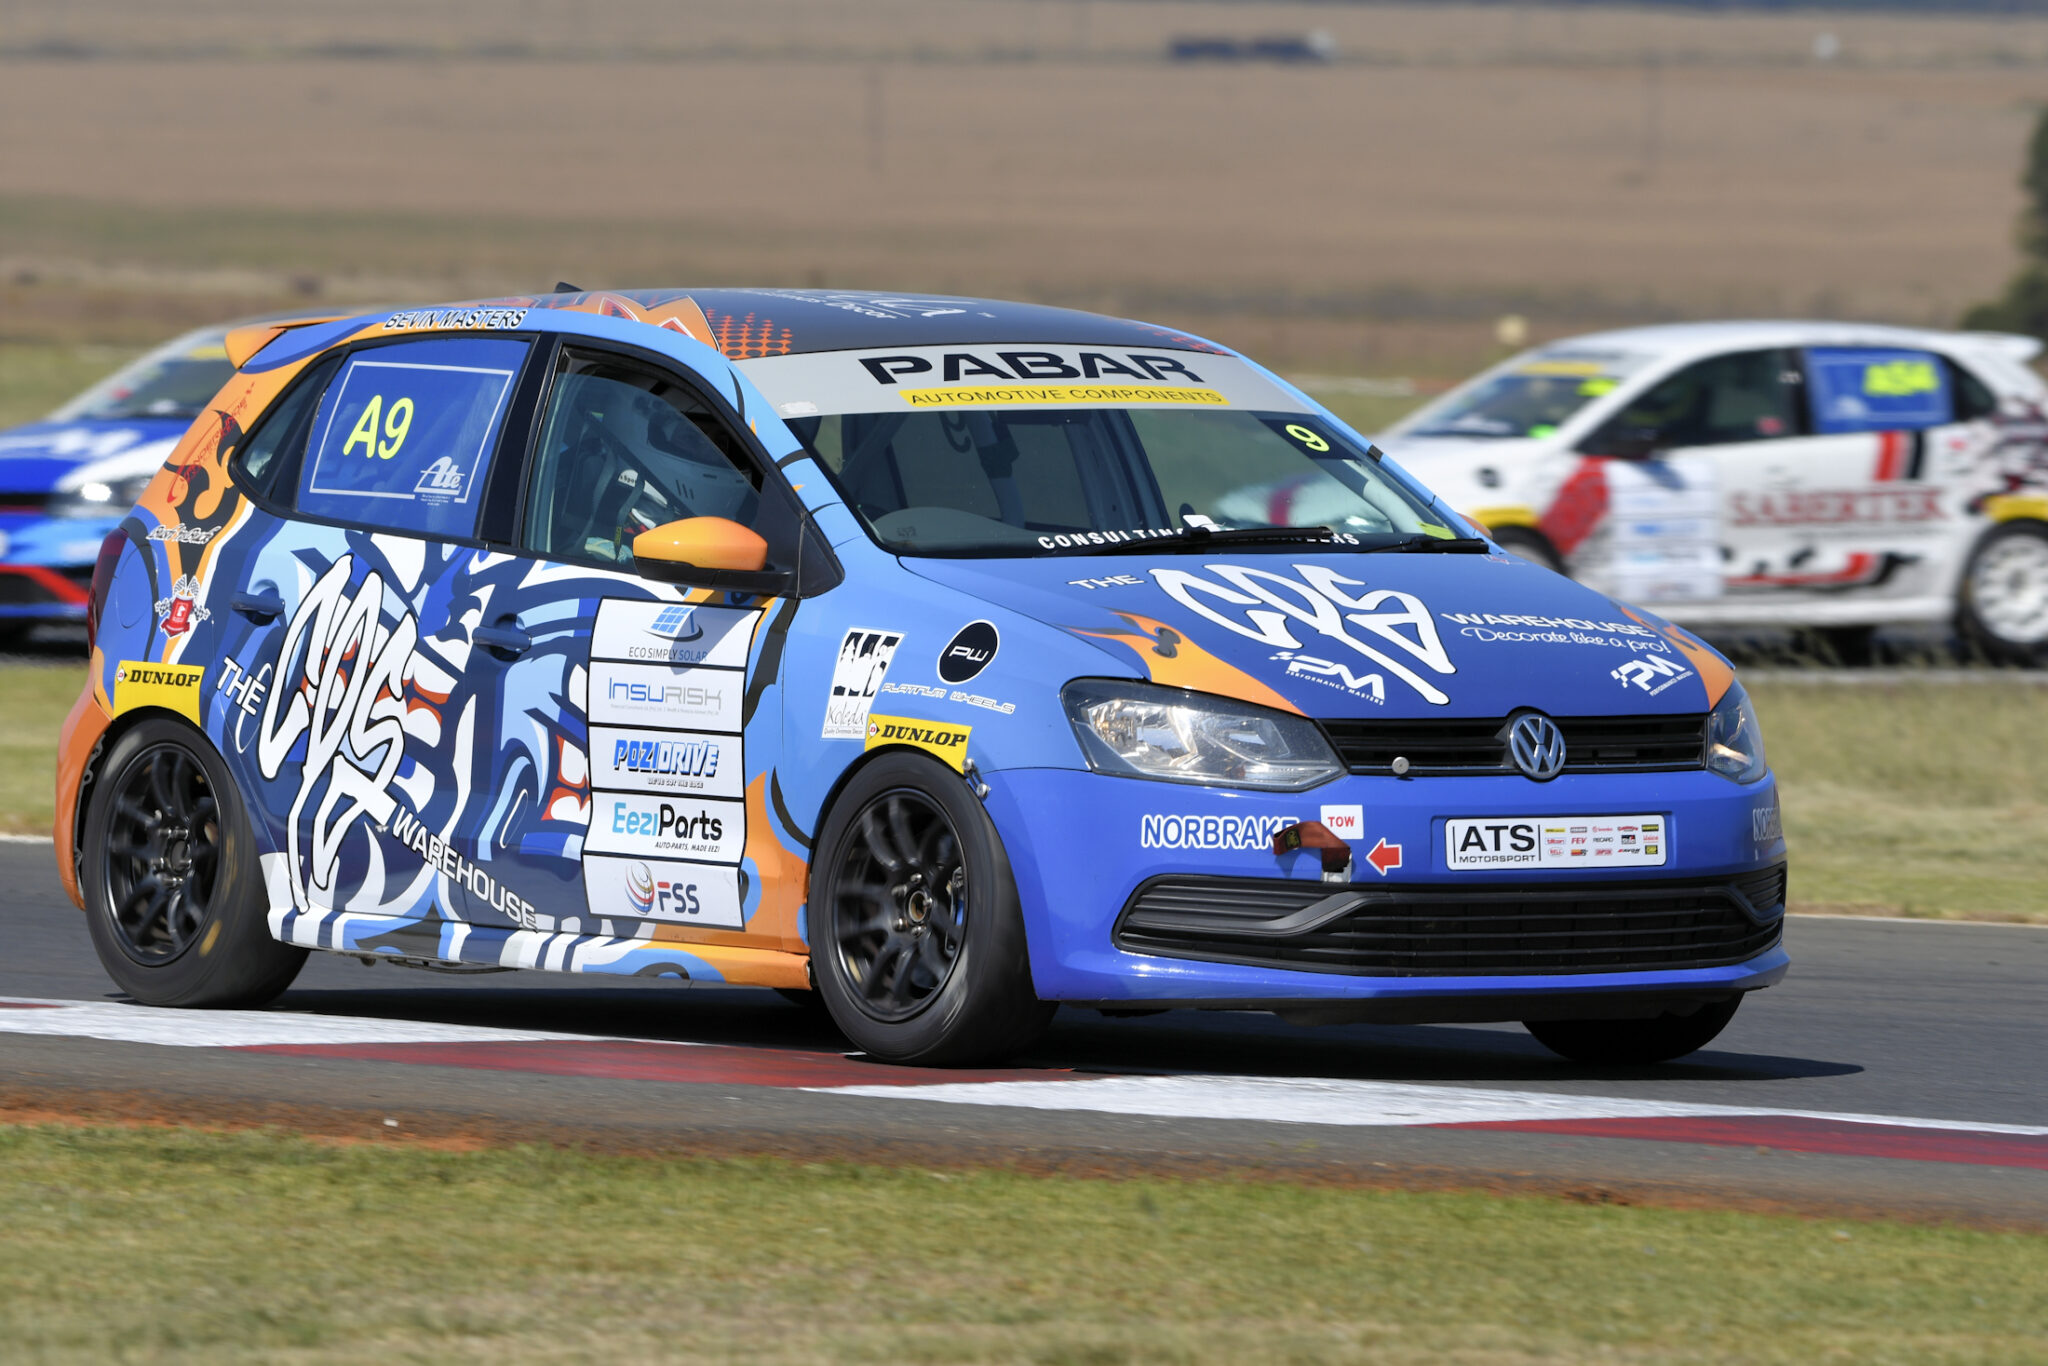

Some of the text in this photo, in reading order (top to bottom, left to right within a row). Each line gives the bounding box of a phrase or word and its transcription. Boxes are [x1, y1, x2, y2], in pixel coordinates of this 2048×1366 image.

[383, 308, 528, 330] BEVIN MASTERS
[858, 351, 1206, 385] PABAR
[911, 389, 1222, 405] AUTOMOTIVE COMPONENTS
[343, 394, 414, 460] A9
[1285, 424, 1330, 452] 9
[414, 456, 466, 495] Ate
[1067, 574, 1146, 591] THE
[1440, 612, 1657, 639] WAREHOUSE
[628, 646, 647, 658] ECO
[678, 651, 708, 663] SOLAR
[949, 645, 989, 662] PW
[1460, 627, 1673, 655] Decorate like a pro!
[129, 669, 200, 687] DUNLOP
[216, 656, 266, 716] THE
[1287, 655, 1386, 700] PM
[1617, 653, 1687, 692] PM
[1285, 670, 1385, 706] PERFORMANCE MASTERS
[949, 690, 1016, 715] WHEELS
[881, 724, 967, 748] DUNLOP
[614, 739, 720, 778] POZIDRIVE
[612, 801, 723, 842] EeziParts
[1327, 816, 1355, 828] TOW
[1459, 824, 1536, 853] ATS
[392, 804, 539, 932] WAREHOUSE
[1459, 855, 1537, 864] MOTORSPORT
[657, 882, 701, 915] FSS
